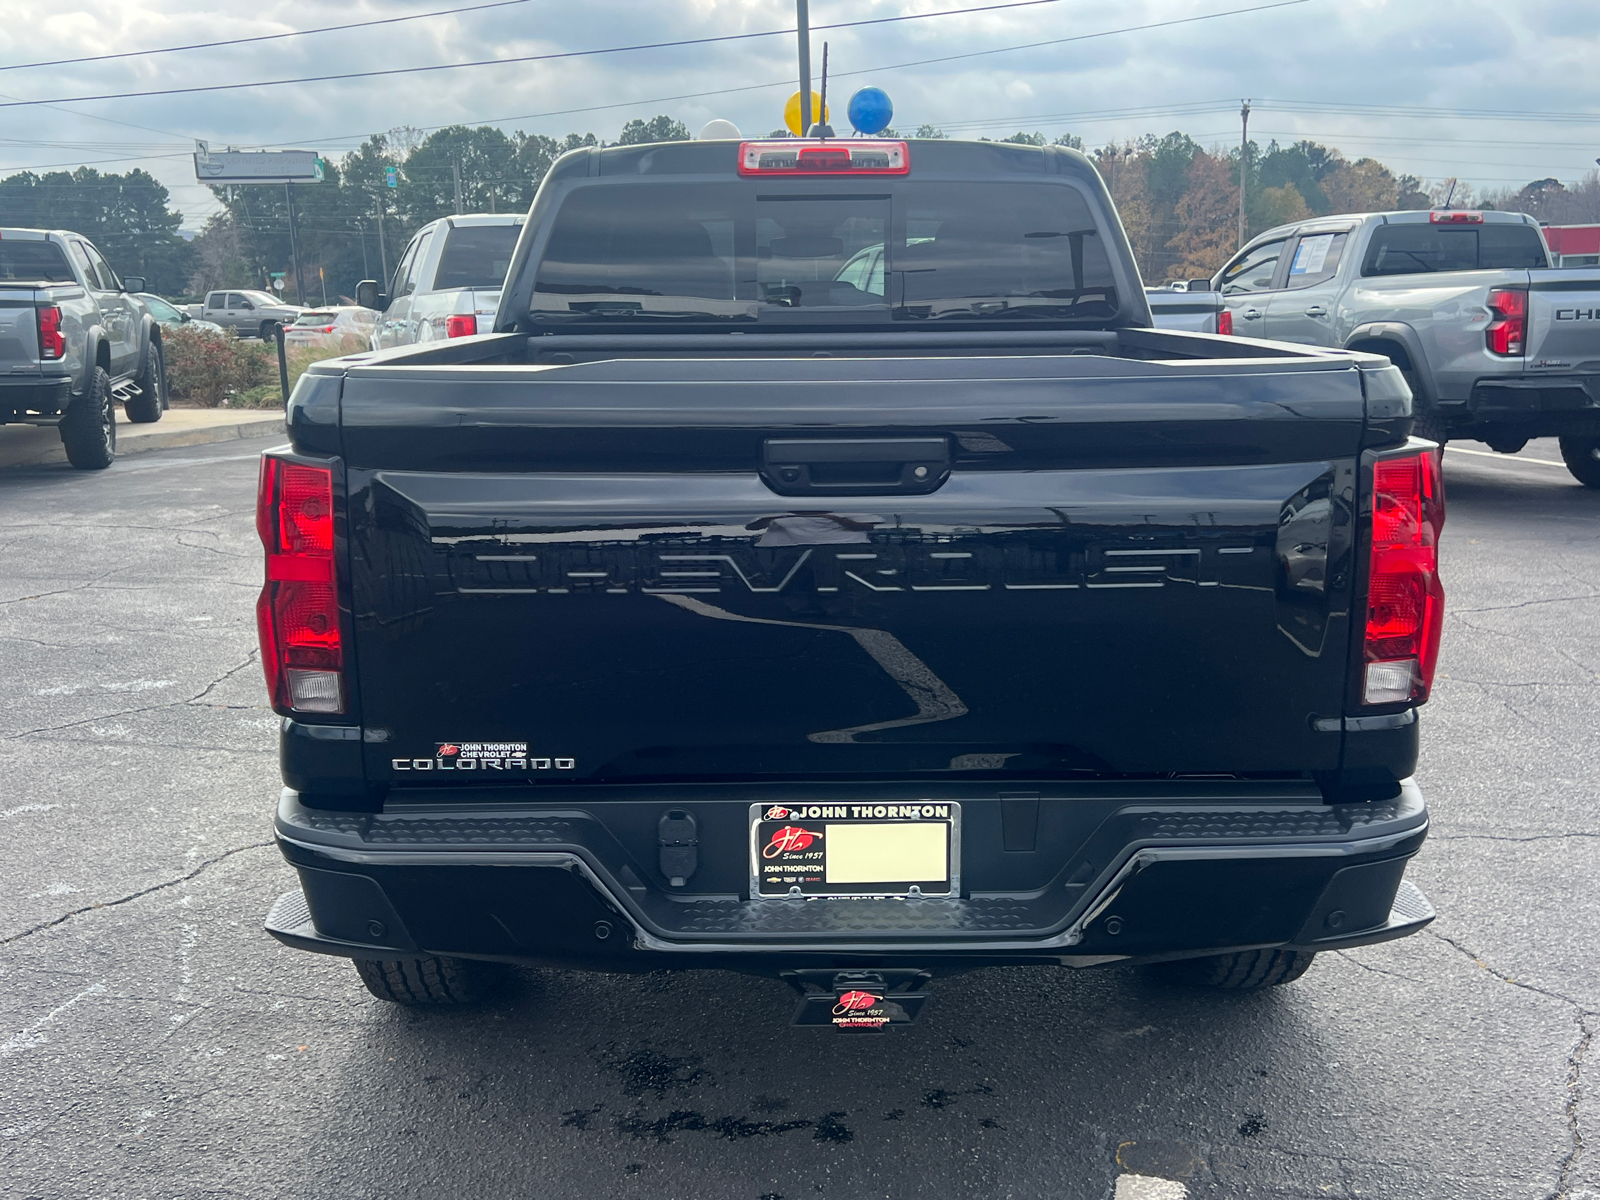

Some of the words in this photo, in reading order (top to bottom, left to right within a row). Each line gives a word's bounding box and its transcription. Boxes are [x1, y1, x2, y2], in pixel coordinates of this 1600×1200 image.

[1556, 309, 1600, 321] CH
[460, 743, 483, 751] JOHN
[484, 743, 527, 751] THORNTON
[391, 758, 575, 770] COLORADO
[799, 805, 847, 819] JOHN
[851, 805, 949, 819] THORNTON
[782, 851, 804, 860] Since
[804, 851, 824, 860] 1957
[763, 864, 783, 873] JOHN
[783, 864, 824, 873] THORNTON
[847, 1009, 866, 1017] Since
